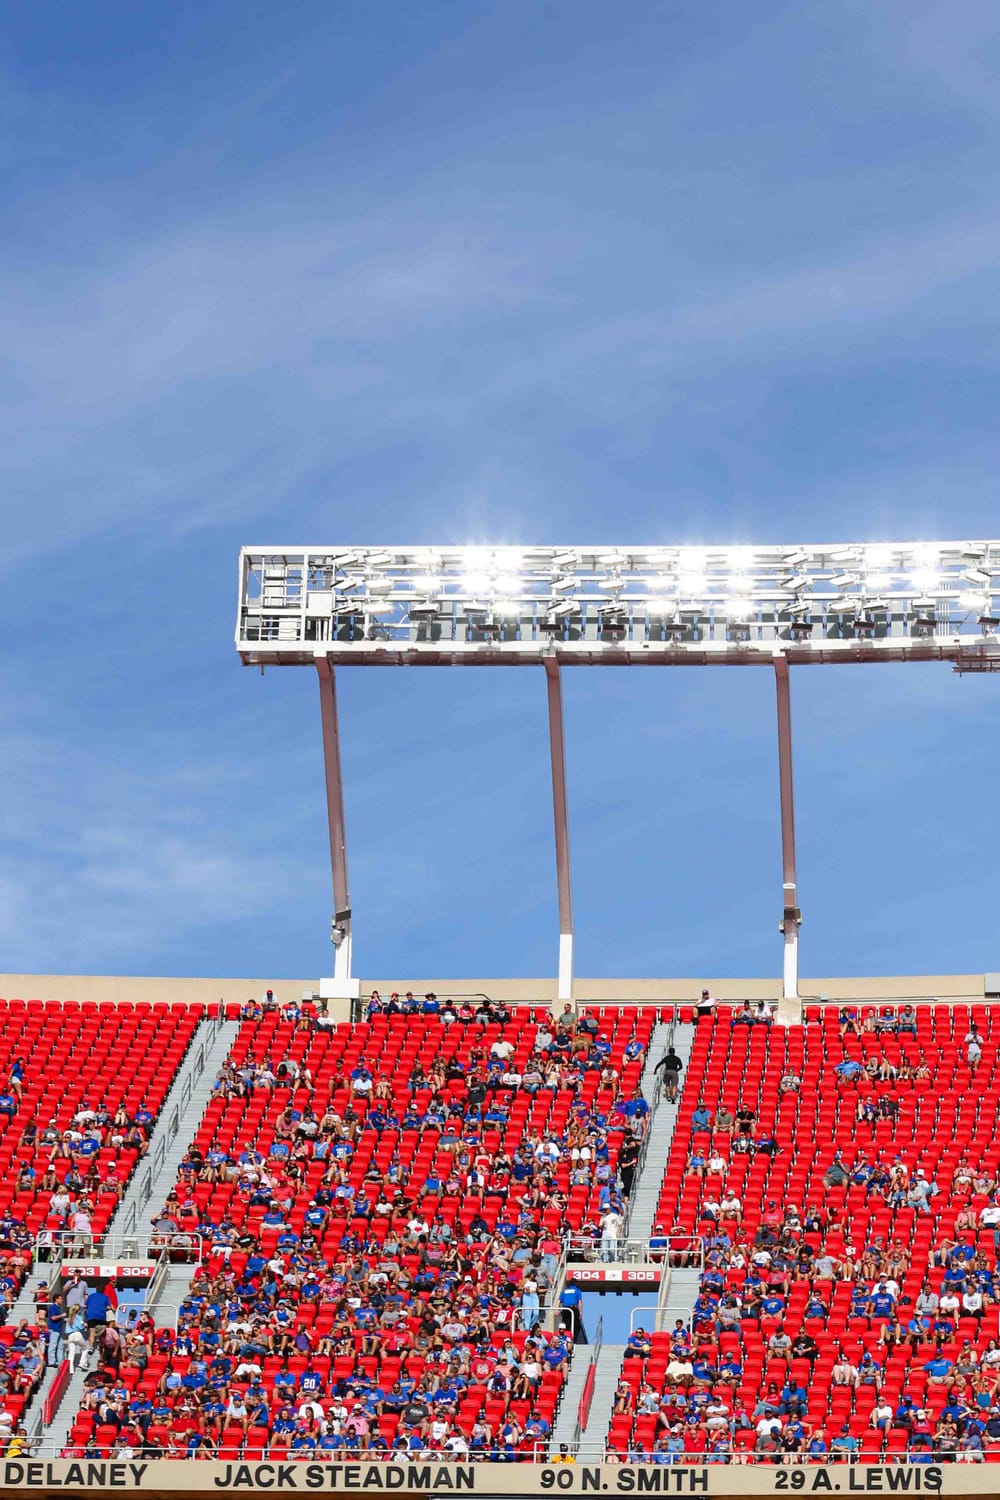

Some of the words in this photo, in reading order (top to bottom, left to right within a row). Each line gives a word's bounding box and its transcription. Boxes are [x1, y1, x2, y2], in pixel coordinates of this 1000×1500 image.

[122, 1267, 149, 1276] 304
[573, 1271, 600, 1280] 304
[628, 1271, 655, 1280] 305
[303, 1378, 315, 1389] 20
[5, 1462, 147, 1486] DELANEY
[215, 1464, 298, 1488] JACK
[306, 1465, 475, 1489] STEADMAN
[541, 1469, 574, 1489] 90
[582, 1468, 609, 1490] N.
[617, 1468, 709, 1492] SMITH
[775, 1469, 806, 1490] 29
[812, 1468, 841, 1491] A.
[850, 1467, 943, 1491] LEWIS
